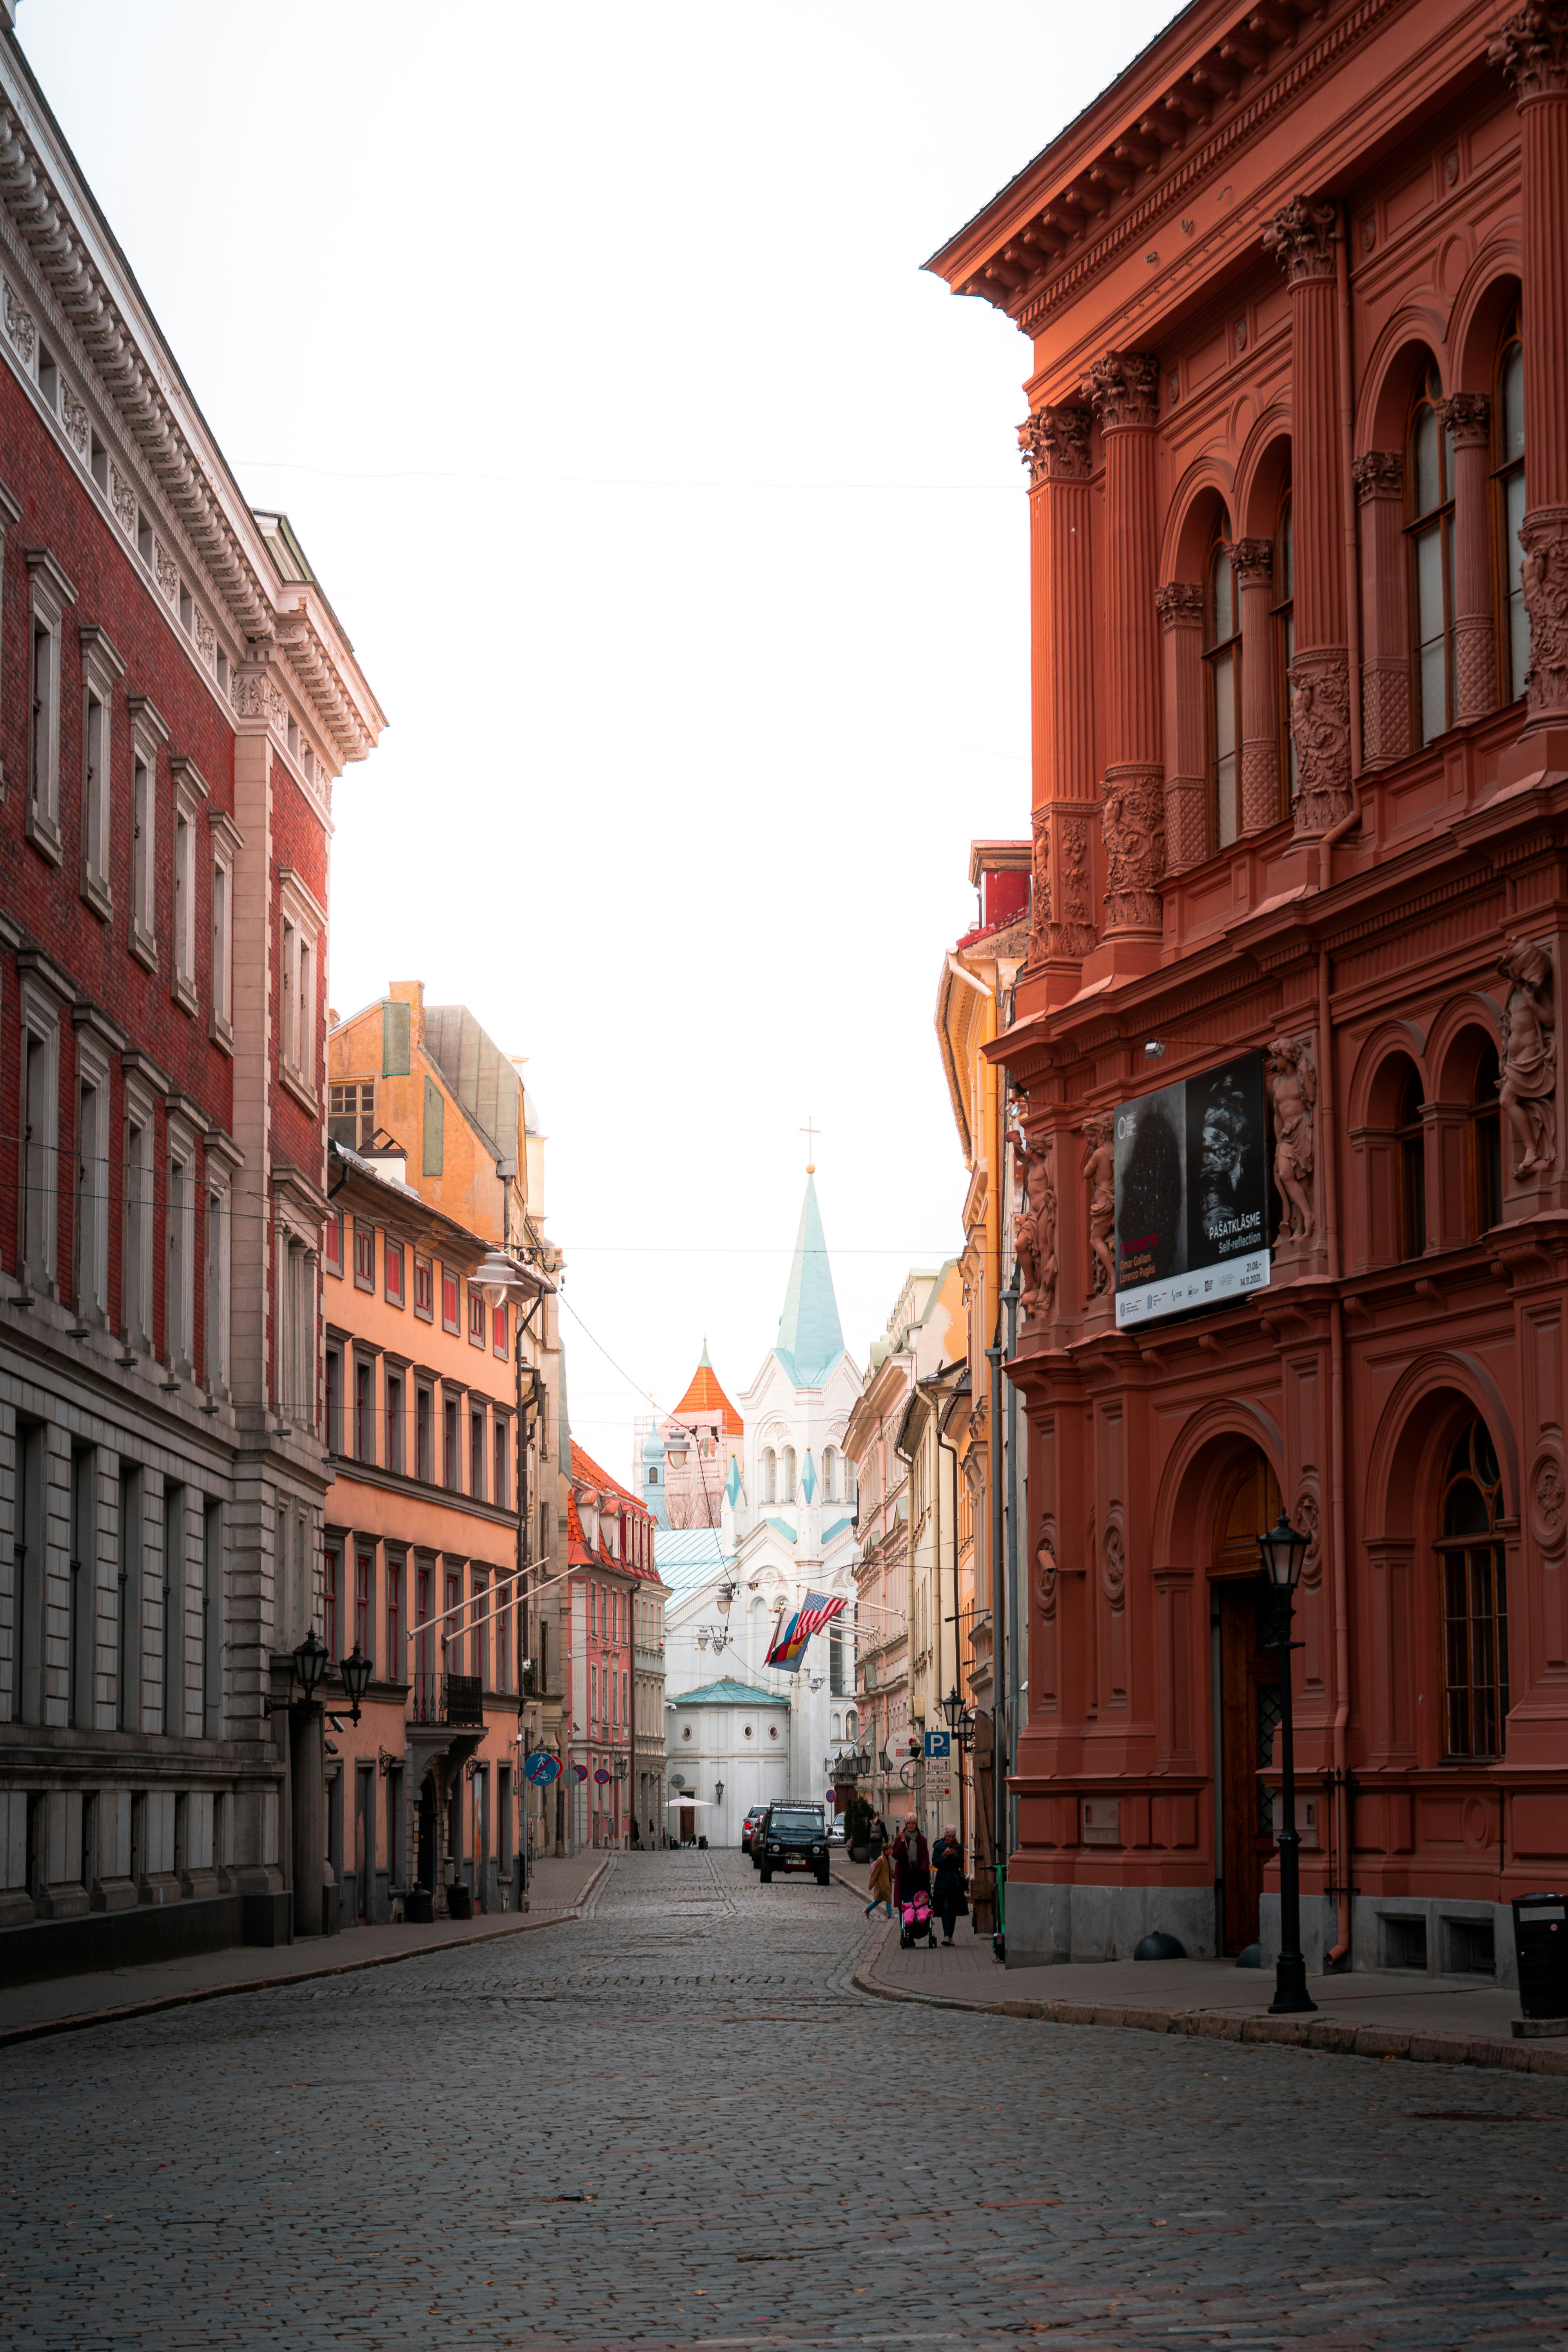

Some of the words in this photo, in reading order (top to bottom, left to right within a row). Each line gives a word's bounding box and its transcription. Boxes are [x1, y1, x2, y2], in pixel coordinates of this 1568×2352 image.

[1209, 1211, 1261, 1240] PAŠATKLĀSME
[1120, 1232, 1159, 1256] TINTORETTO
[1219, 1232, 1261, 1254] Self-reflection
[1120, 1260, 1132, 1270] Omar
[1133, 1251, 1151, 1267] Galliani
[1120, 1270, 1139, 1283] Lorenzo
[1139, 1263, 1156, 1277] Puglisi
[930, 1735, 944, 1754] P
